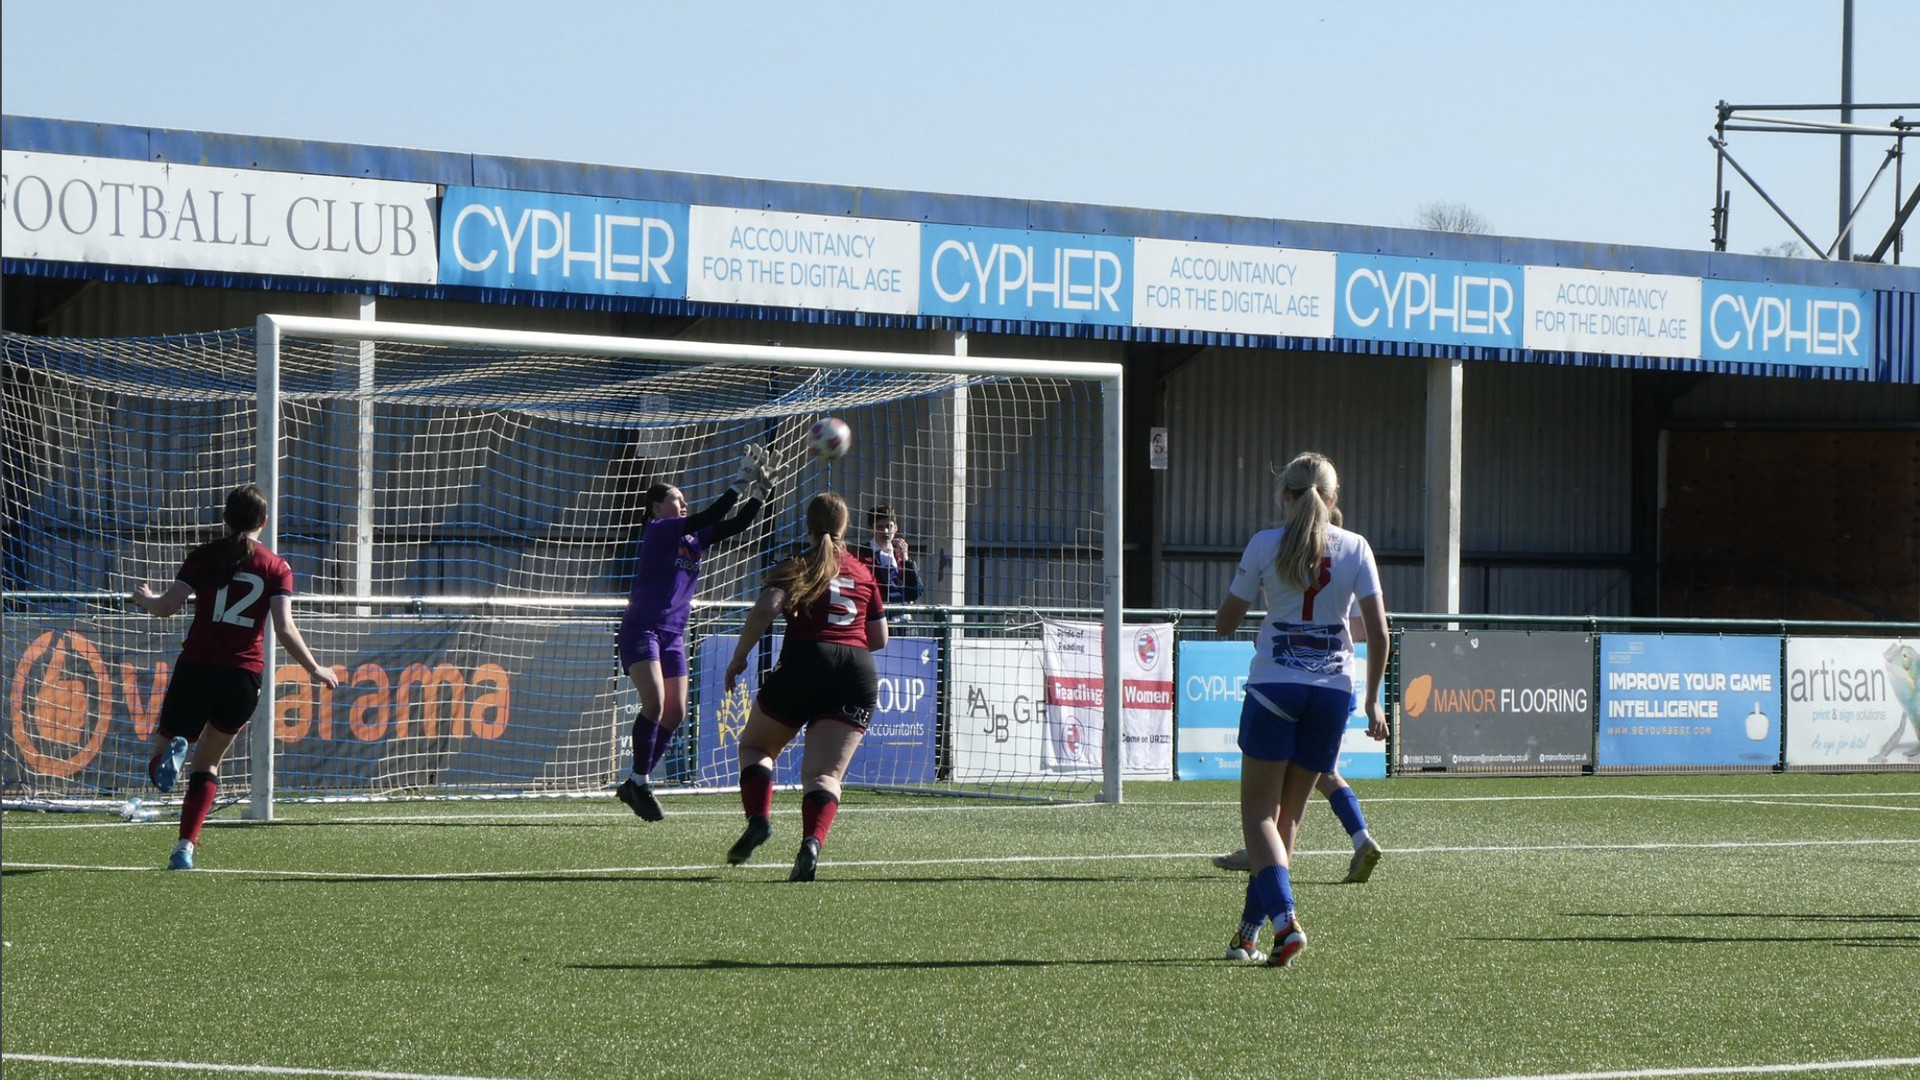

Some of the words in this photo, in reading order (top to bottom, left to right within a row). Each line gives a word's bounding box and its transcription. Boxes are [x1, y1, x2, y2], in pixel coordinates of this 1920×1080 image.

[286, 197, 417, 257] CLUB
[730, 226, 875, 259] ACCOUNTANCY
[453, 204, 674, 285] CYPHER
[703, 256, 743, 281] FOR
[747, 260, 784, 285] THE
[790, 262, 861, 291] DIGITAL
[864, 267, 901, 293] AGE
[931, 240, 1122, 313] CYPHER
[1170, 256, 1297, 287] ACCOUNTANCY
[1146, 285, 1181, 309] FOR
[1185, 287, 1216, 311] THE
[1222, 289, 1283, 316] DIGITAL
[1286, 293, 1319, 318] AGE
[1345, 268, 1513, 336] CYPHER
[1556, 281, 1668, 310] ACCOUNTANCY
[1536, 311, 1566, 332] FOR
[1570, 312, 1597, 334] THE
[1602, 315, 1655, 338] DIGITAL
[1657, 318, 1687, 339] AGE
[1711, 293, 1861, 356] CYPHER
[212, 572, 265, 628] 12
[827, 577, 858, 626] 5
[1058, 642, 1085, 653] Reading
[876, 677, 925, 713] OUP
[1055, 682, 1103, 705] Reading
[1124, 685, 1170, 704] Women
[1186, 675, 1248, 702] CYPHE
[1608, 672, 1680, 691] IMPROVE
[1684, 673, 1726, 692] YOUR
[1730, 673, 1772, 692] GAME
[1790, 659, 1886, 702] artisan
[121, 662, 510, 742] varama
[1434, 688, 1496, 713] MANOR
[1501, 687, 1588, 713] FLOORING
[1608, 700, 1718, 718] INTELLIGENCE
[1812, 709, 1830, 721] print
[1840, 709, 1854, 723] sign
[1856, 709, 1886, 720] solutions
